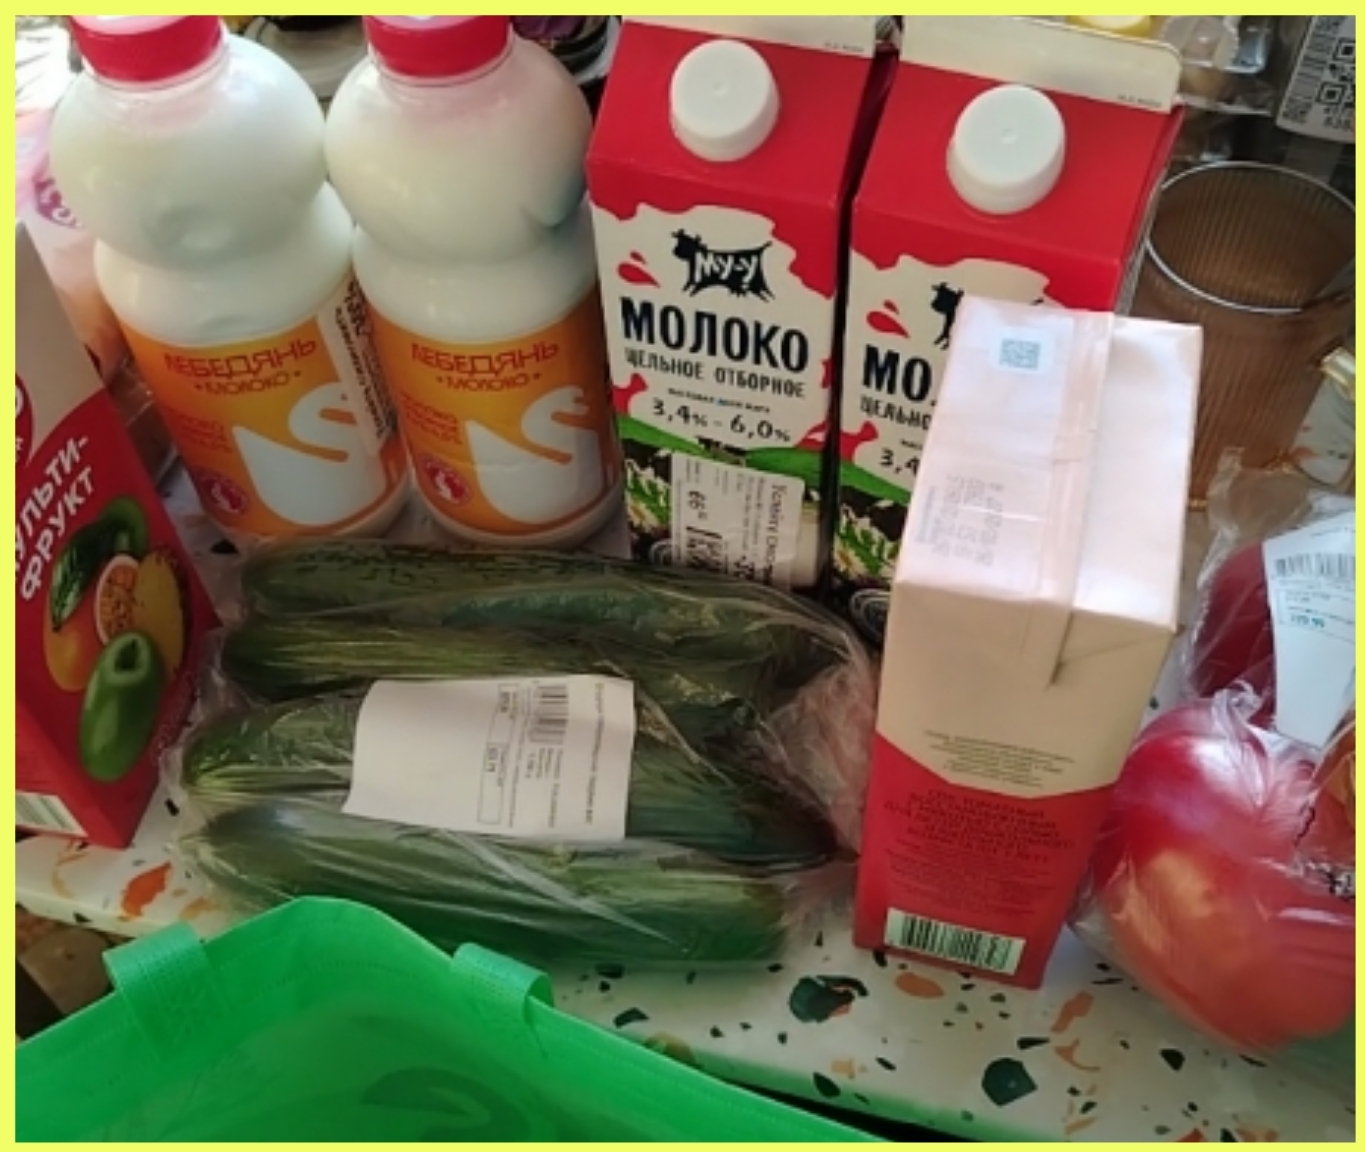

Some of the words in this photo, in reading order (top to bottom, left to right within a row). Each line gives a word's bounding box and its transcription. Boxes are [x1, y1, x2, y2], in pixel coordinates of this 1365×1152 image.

[620, 296, 809, 374] МОЛОКО
[164, 339, 316, 380] ЛЕБЕДЯНЬ
[411, 343, 559, 378] ЛЕБЕДЯНЬ
[625, 347, 704, 381] ЦЕЛЬНОЕ
[715, 367, 806, 399] ОТБОРНОЕ
[730, 413, 792, 443] 6,0%
[860, 393, 932, 431] ЦЕЛЬНО
[16, 435, 89, 582] УЛЬТИ-
[20, 466, 96, 602] ФРУКТ
